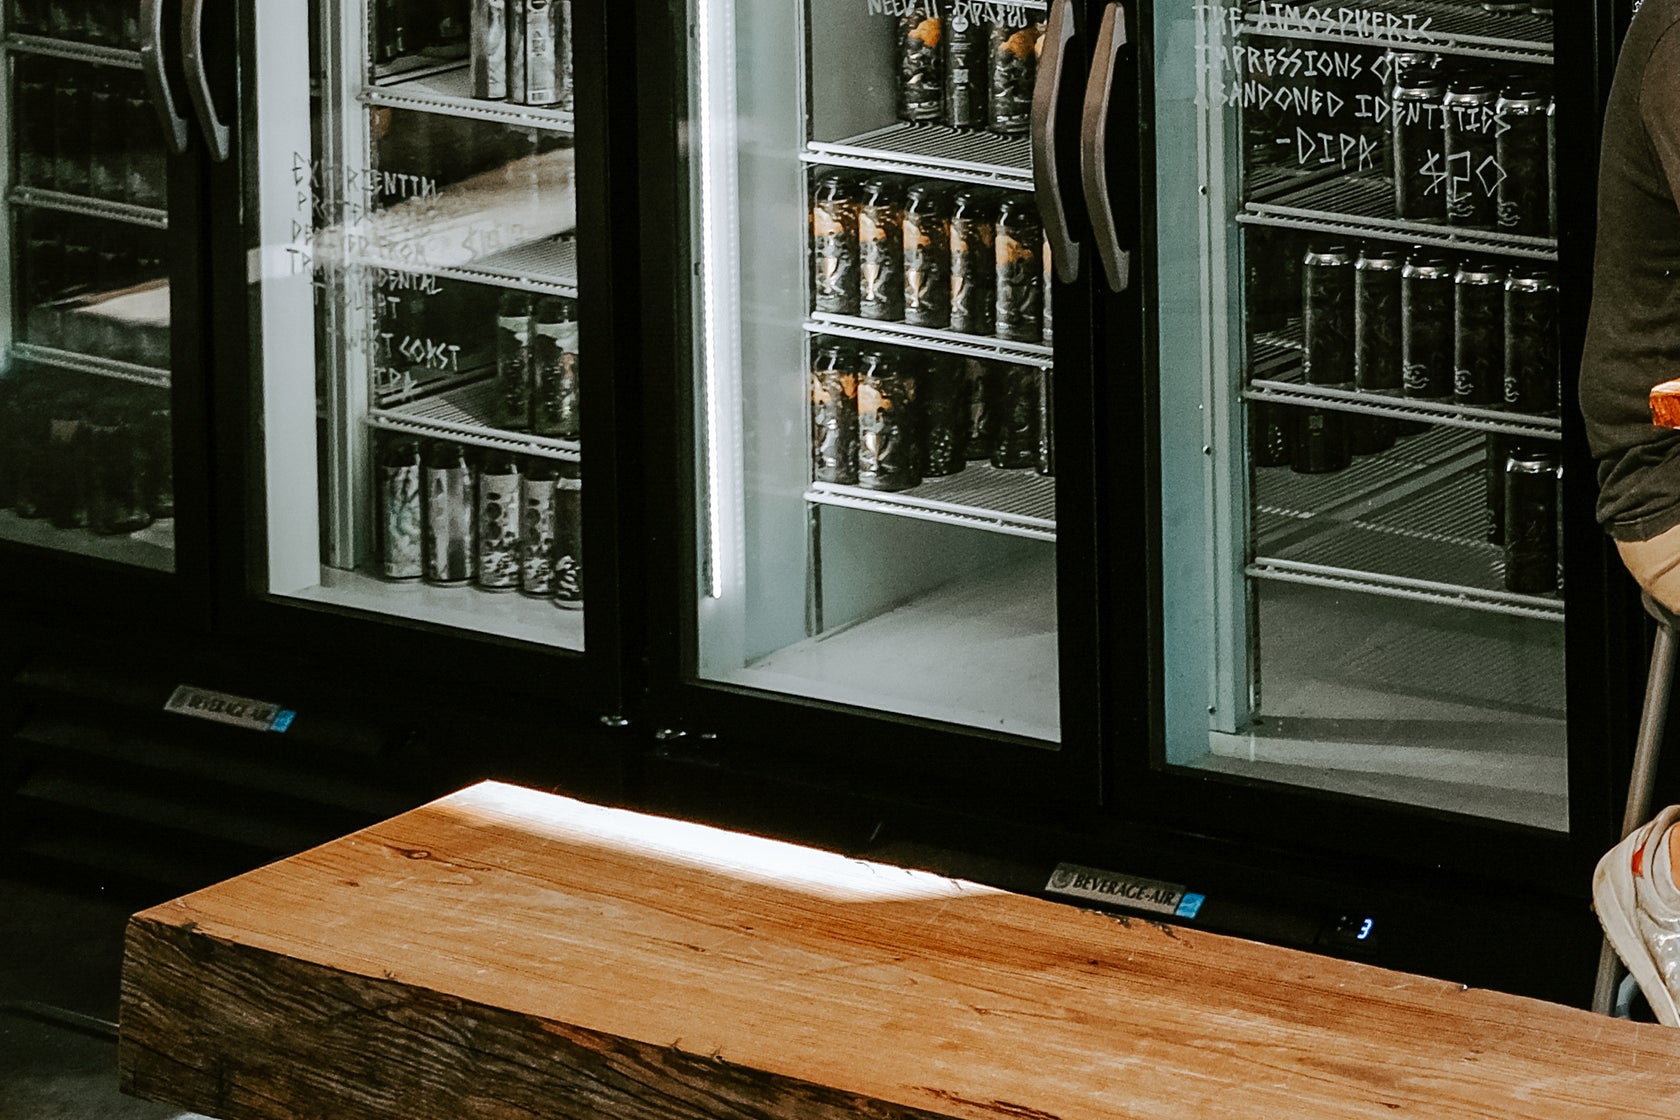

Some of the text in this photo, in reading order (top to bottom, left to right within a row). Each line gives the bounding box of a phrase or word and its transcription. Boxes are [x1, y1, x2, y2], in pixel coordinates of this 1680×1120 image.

[1256, 0, 1436, 43] ATMOSPHERIC
[1370, 50, 1408, 86] OF
[1354, 93, 1512, 139] IDENTITIES
[1418, 147, 1508, 203] $20
[400, 335, 461, 372] COAST
[1356, 918, 1373, 940] 3
